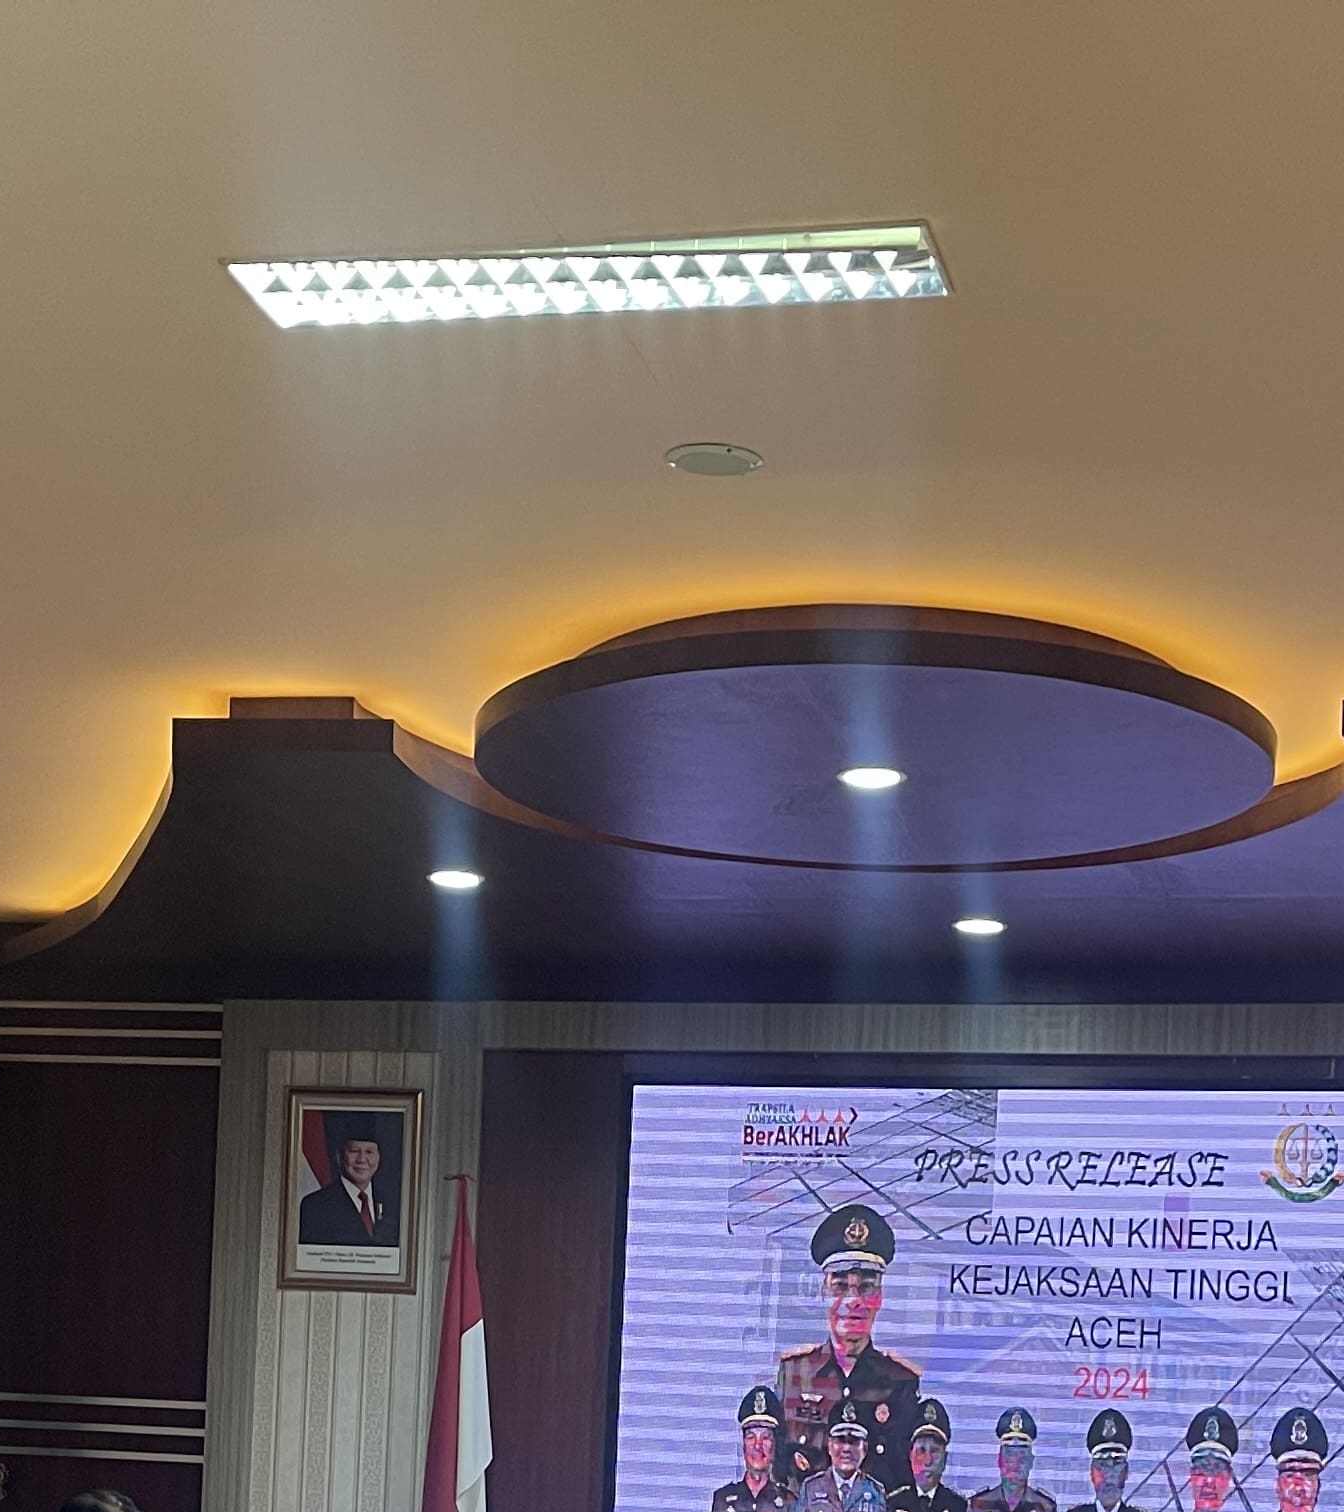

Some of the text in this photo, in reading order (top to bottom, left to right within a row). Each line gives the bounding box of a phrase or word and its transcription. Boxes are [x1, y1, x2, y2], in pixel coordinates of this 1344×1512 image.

[743, 1125, 850, 1147] BerAKHLAK
[914, 1148, 1229, 1191] PRESS RELEASE
[965, 1215, 1278, 1251] CAPAIAN KINERJA
[950, 1263, 1152, 1298] KEJAKSAAN
[1065, 1316, 1162, 1349] ACEH
[1072, 1366, 1150, 1399] 2024
